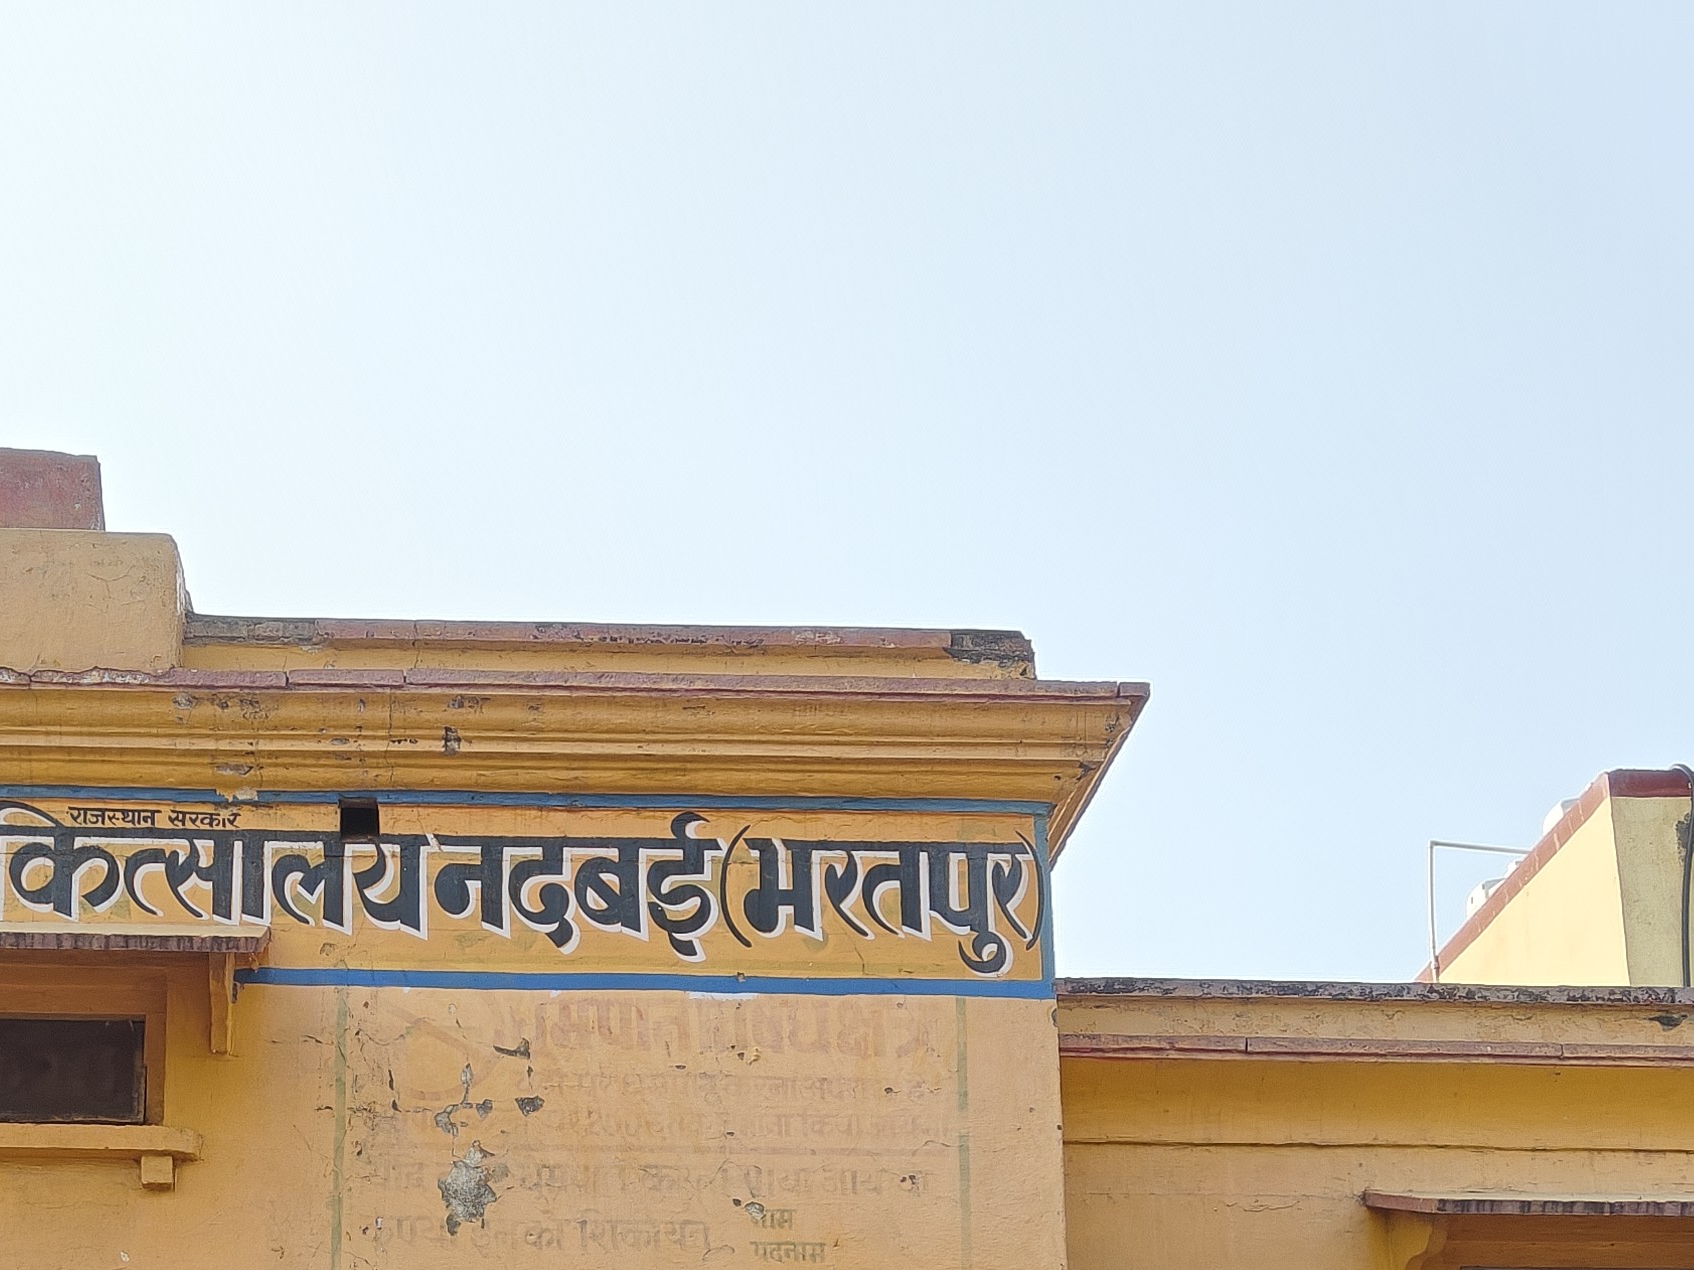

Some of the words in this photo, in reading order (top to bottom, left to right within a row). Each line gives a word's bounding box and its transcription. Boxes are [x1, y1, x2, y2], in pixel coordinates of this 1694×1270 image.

[67, 806, 162, 827] राजस्थान
[167, 808, 242, 829] सरकार
[430, 811, 726, 962] नदबई
[723, 824, 1046, 976] (भरतपुर)
